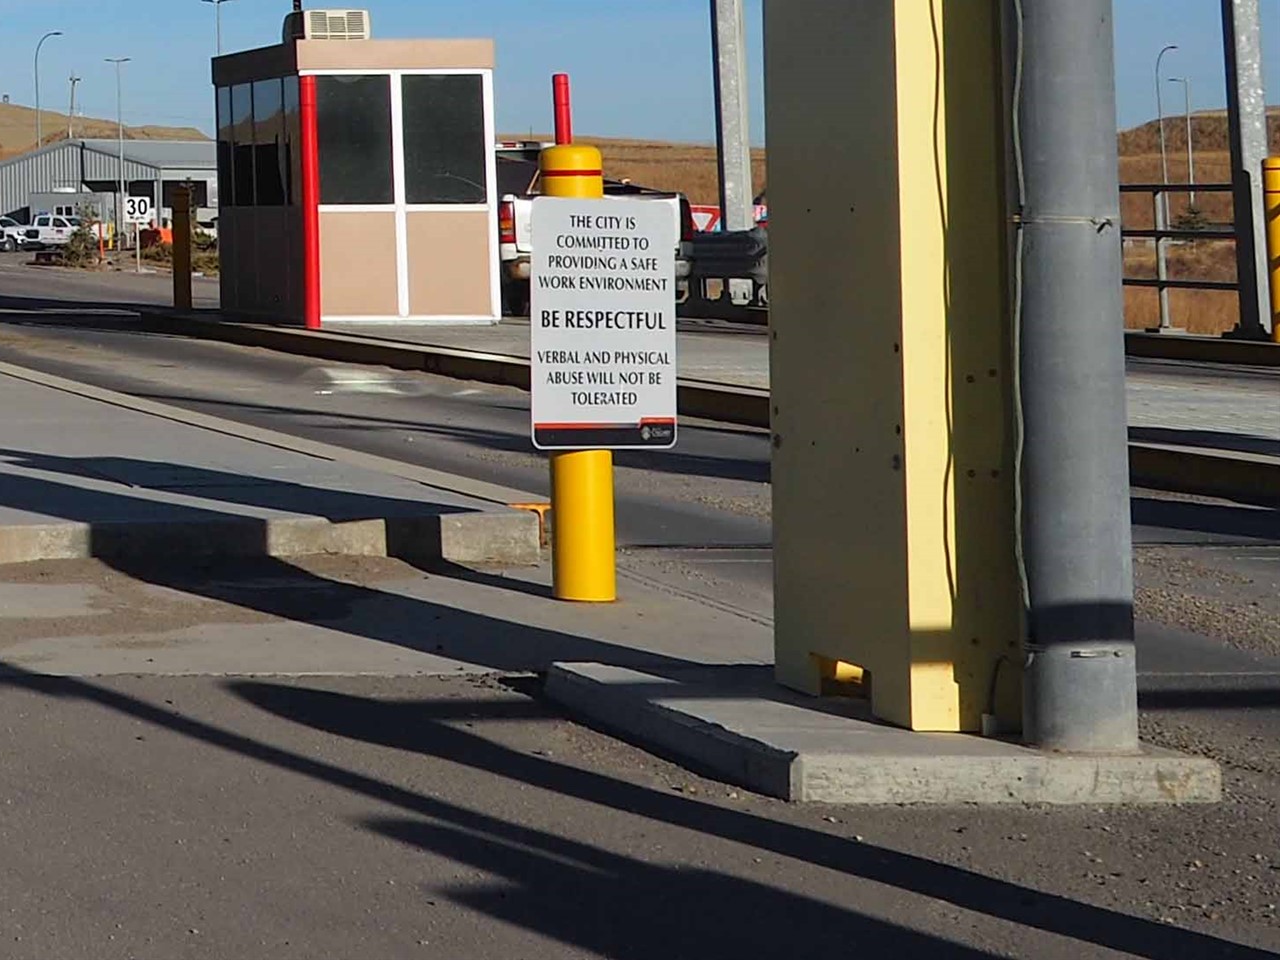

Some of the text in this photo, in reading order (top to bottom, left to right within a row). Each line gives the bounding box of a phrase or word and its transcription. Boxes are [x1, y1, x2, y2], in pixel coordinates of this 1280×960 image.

[127, 199, 147, 215] 30
[570, 215, 636, 229] THE CITY IS
[557, 235, 649, 250] COMMITTED TO
[548, 255, 657, 271] PROVIDING A SAFE
[539, 276, 667, 291] WORK ENVIRONMENT
[541, 310, 666, 330] BE RESPECTFUL
[538, 351, 670, 365] VERBAL AND PHYSICAL
[546, 372, 661, 385] ABUSE WILL NOT BE
[571, 392, 637, 405] TOLERATED
